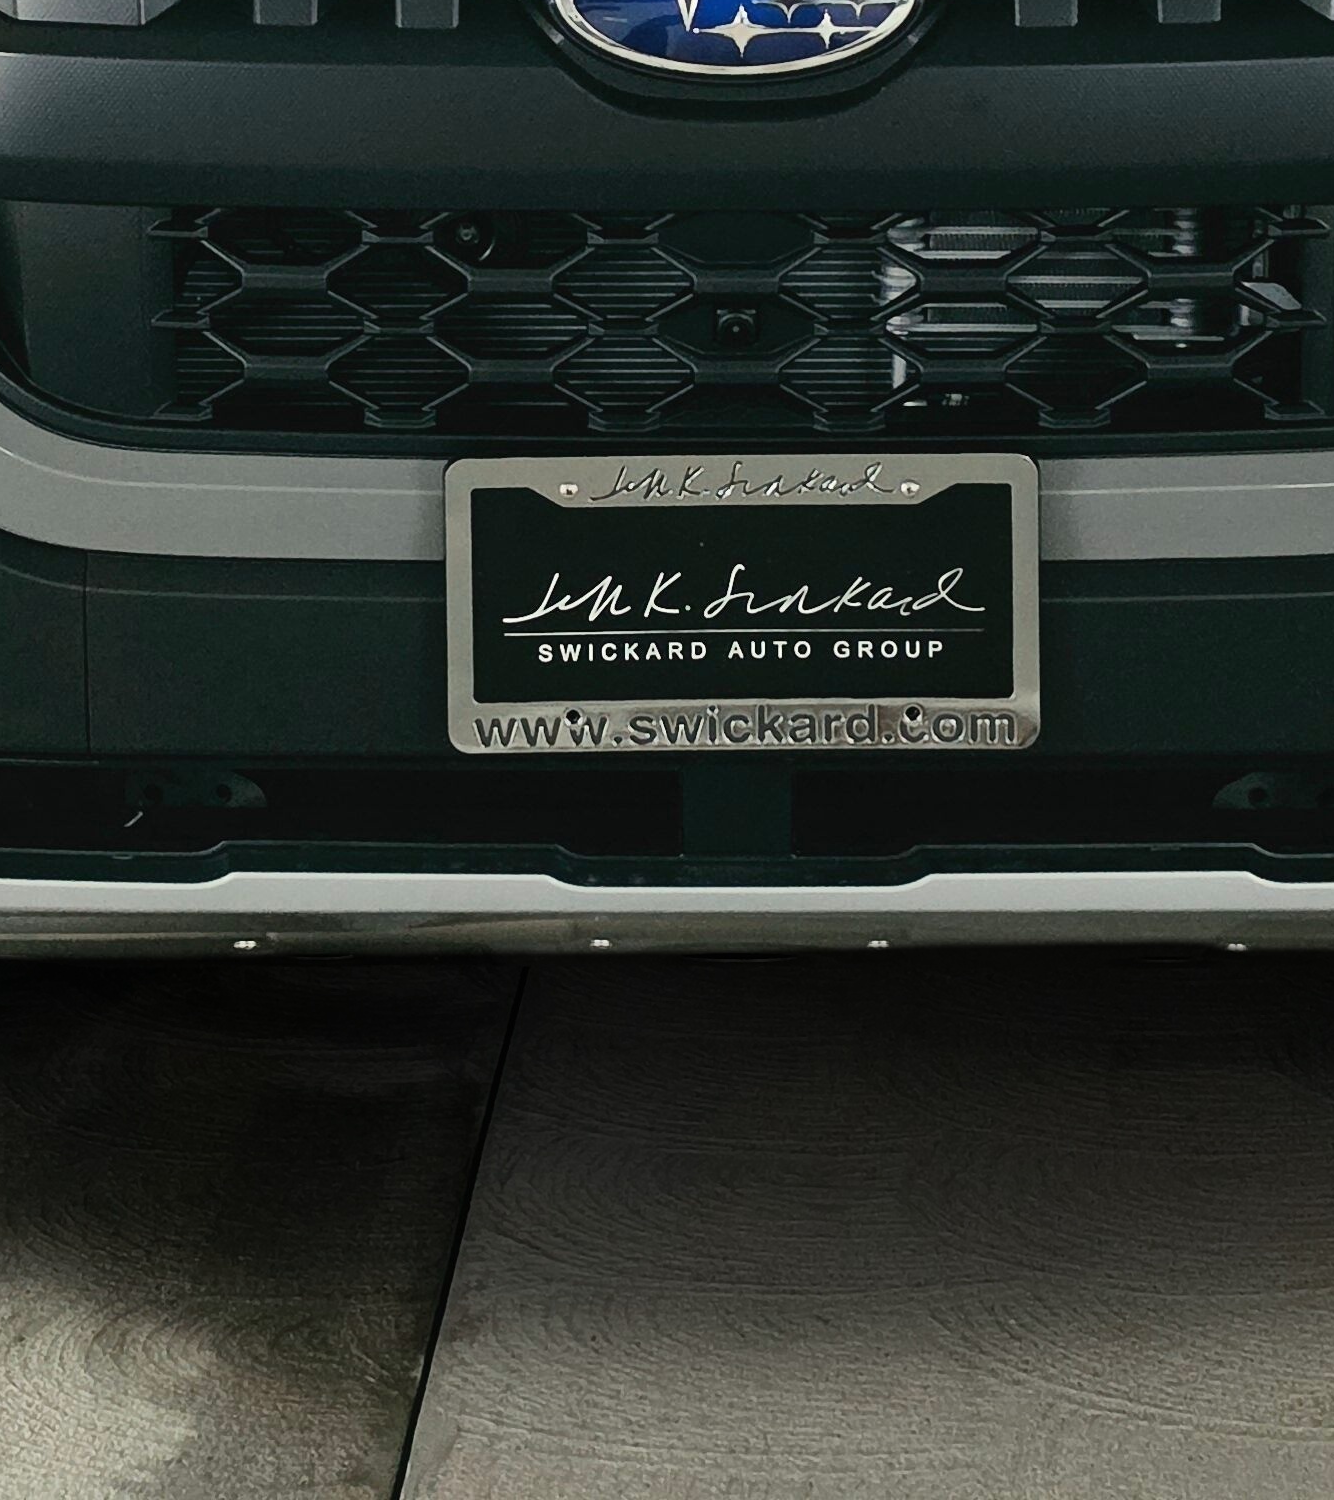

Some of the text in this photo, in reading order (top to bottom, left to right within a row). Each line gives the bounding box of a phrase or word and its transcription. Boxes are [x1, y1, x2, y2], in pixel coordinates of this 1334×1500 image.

[537, 639, 945, 663] SWICKARD AUTO GROUP
[473, 704, 1019, 748] www.swickard.com
